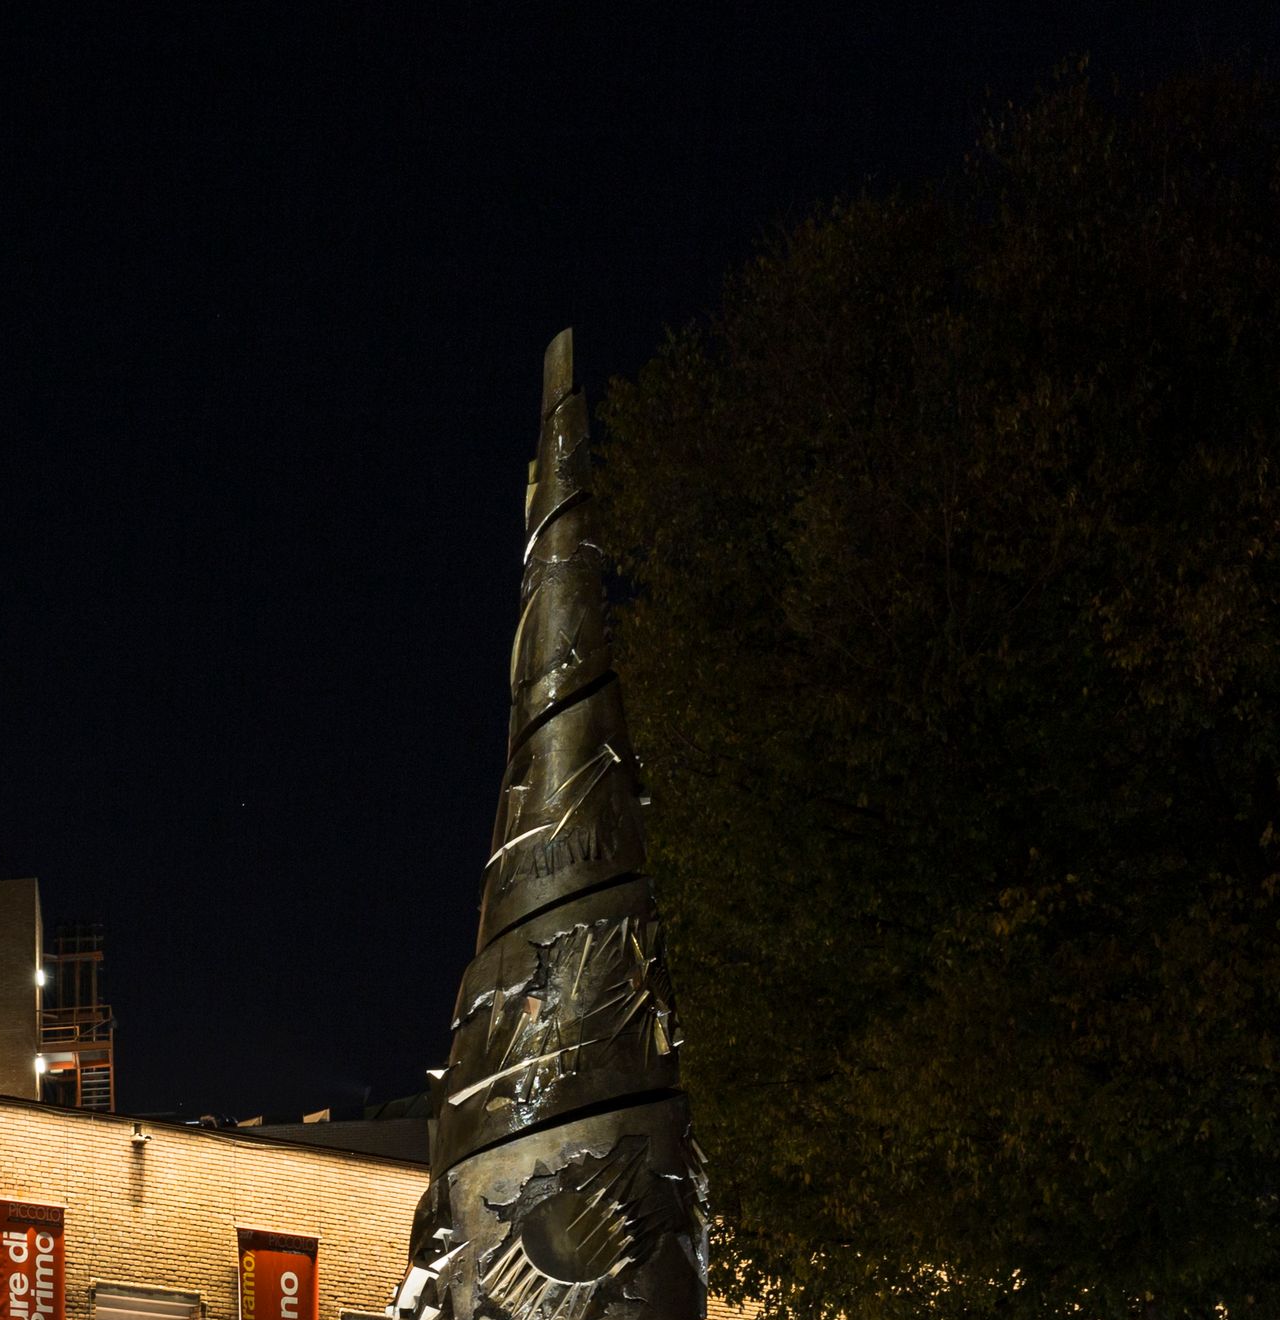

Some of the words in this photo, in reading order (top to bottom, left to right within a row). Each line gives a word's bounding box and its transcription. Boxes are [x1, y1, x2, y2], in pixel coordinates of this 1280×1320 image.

[8, 1203, 61, 1222] PICCOLO
[2, 1231, 28, 1263] di
[280, 1271, 299, 1319] no
